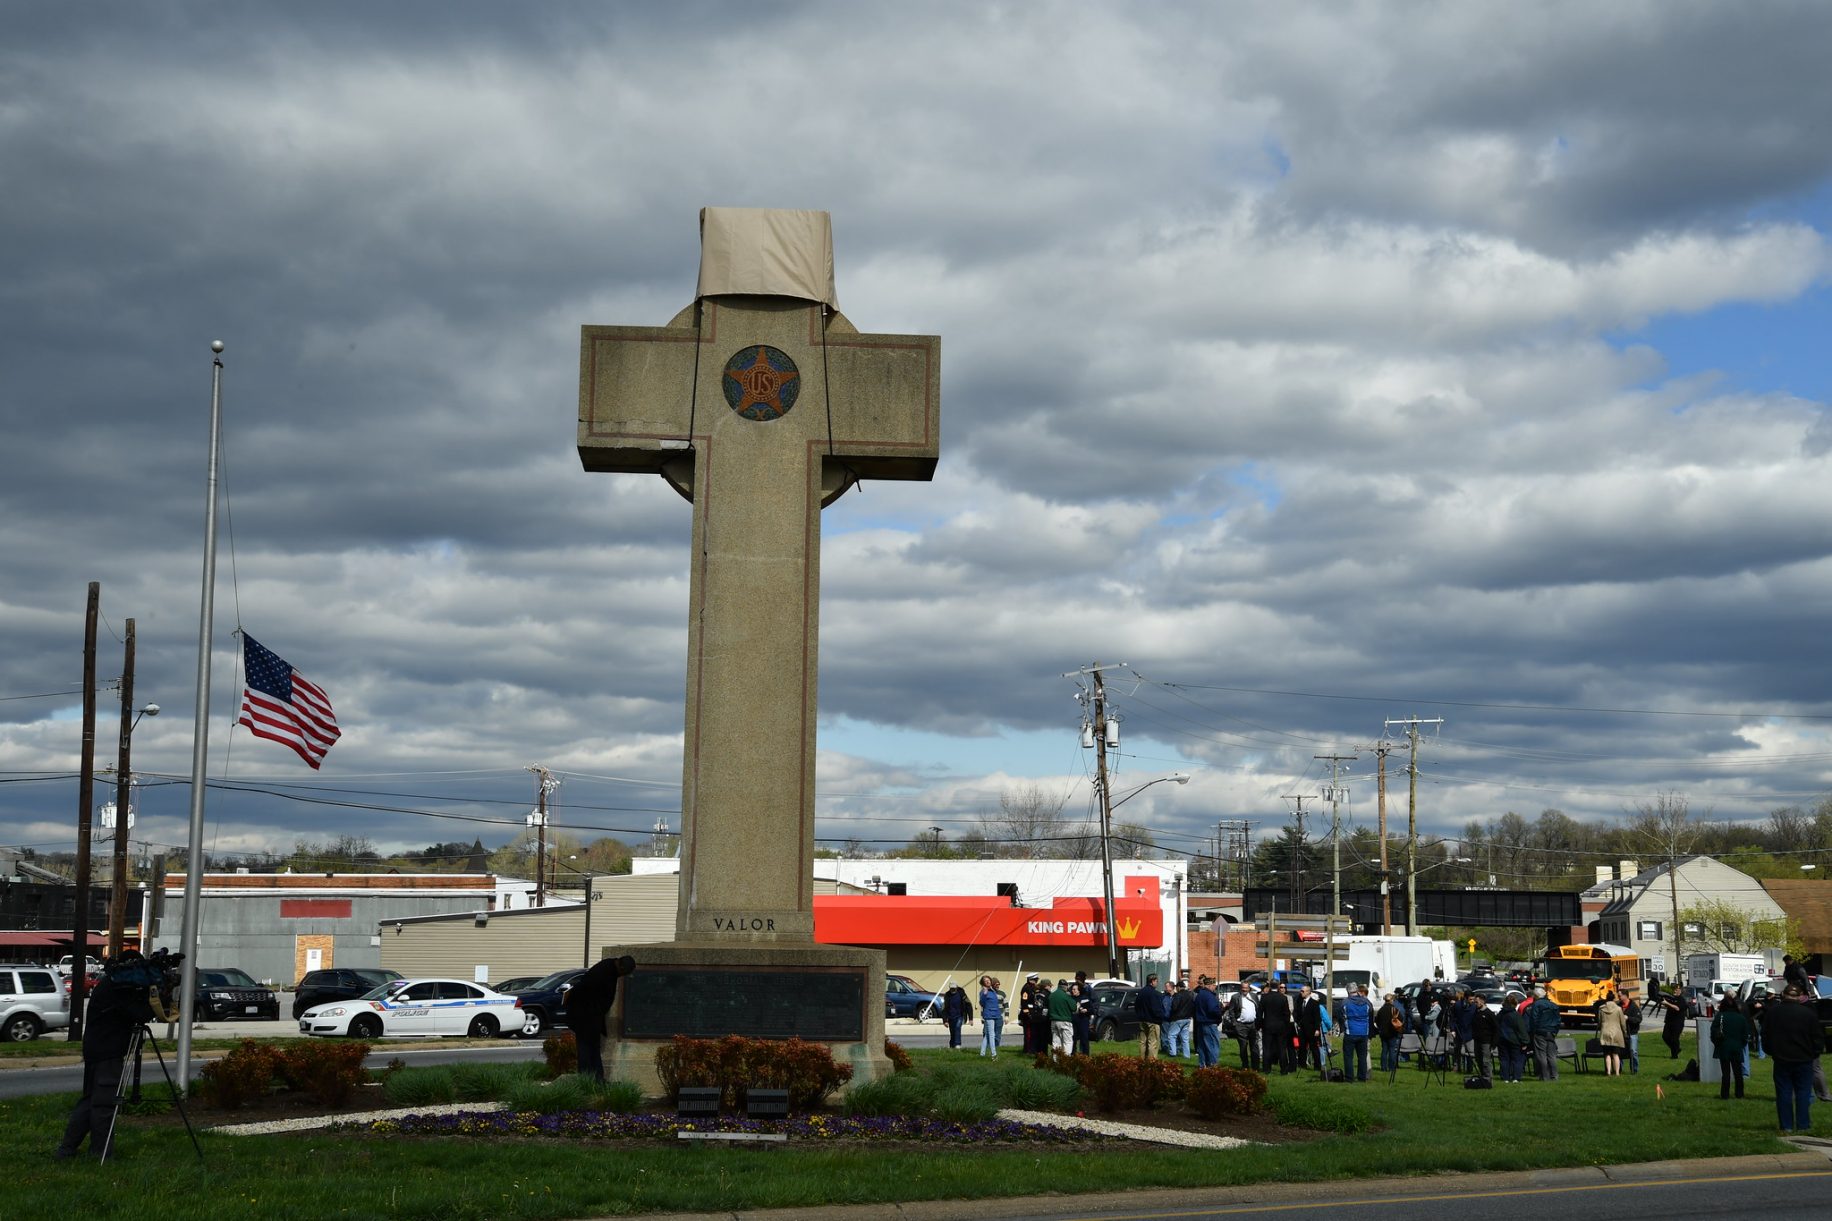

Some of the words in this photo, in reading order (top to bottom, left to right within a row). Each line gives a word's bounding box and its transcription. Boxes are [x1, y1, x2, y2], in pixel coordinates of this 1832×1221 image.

[751, 373, 772, 393] US
[713, 918, 775, 931] VALOR
[1028, 921, 1064, 934] KING
[1067, 921, 1107, 934] PAWN
[1653, 963, 1664, 971] 30
[391, 1009, 429, 1017] POLICE
